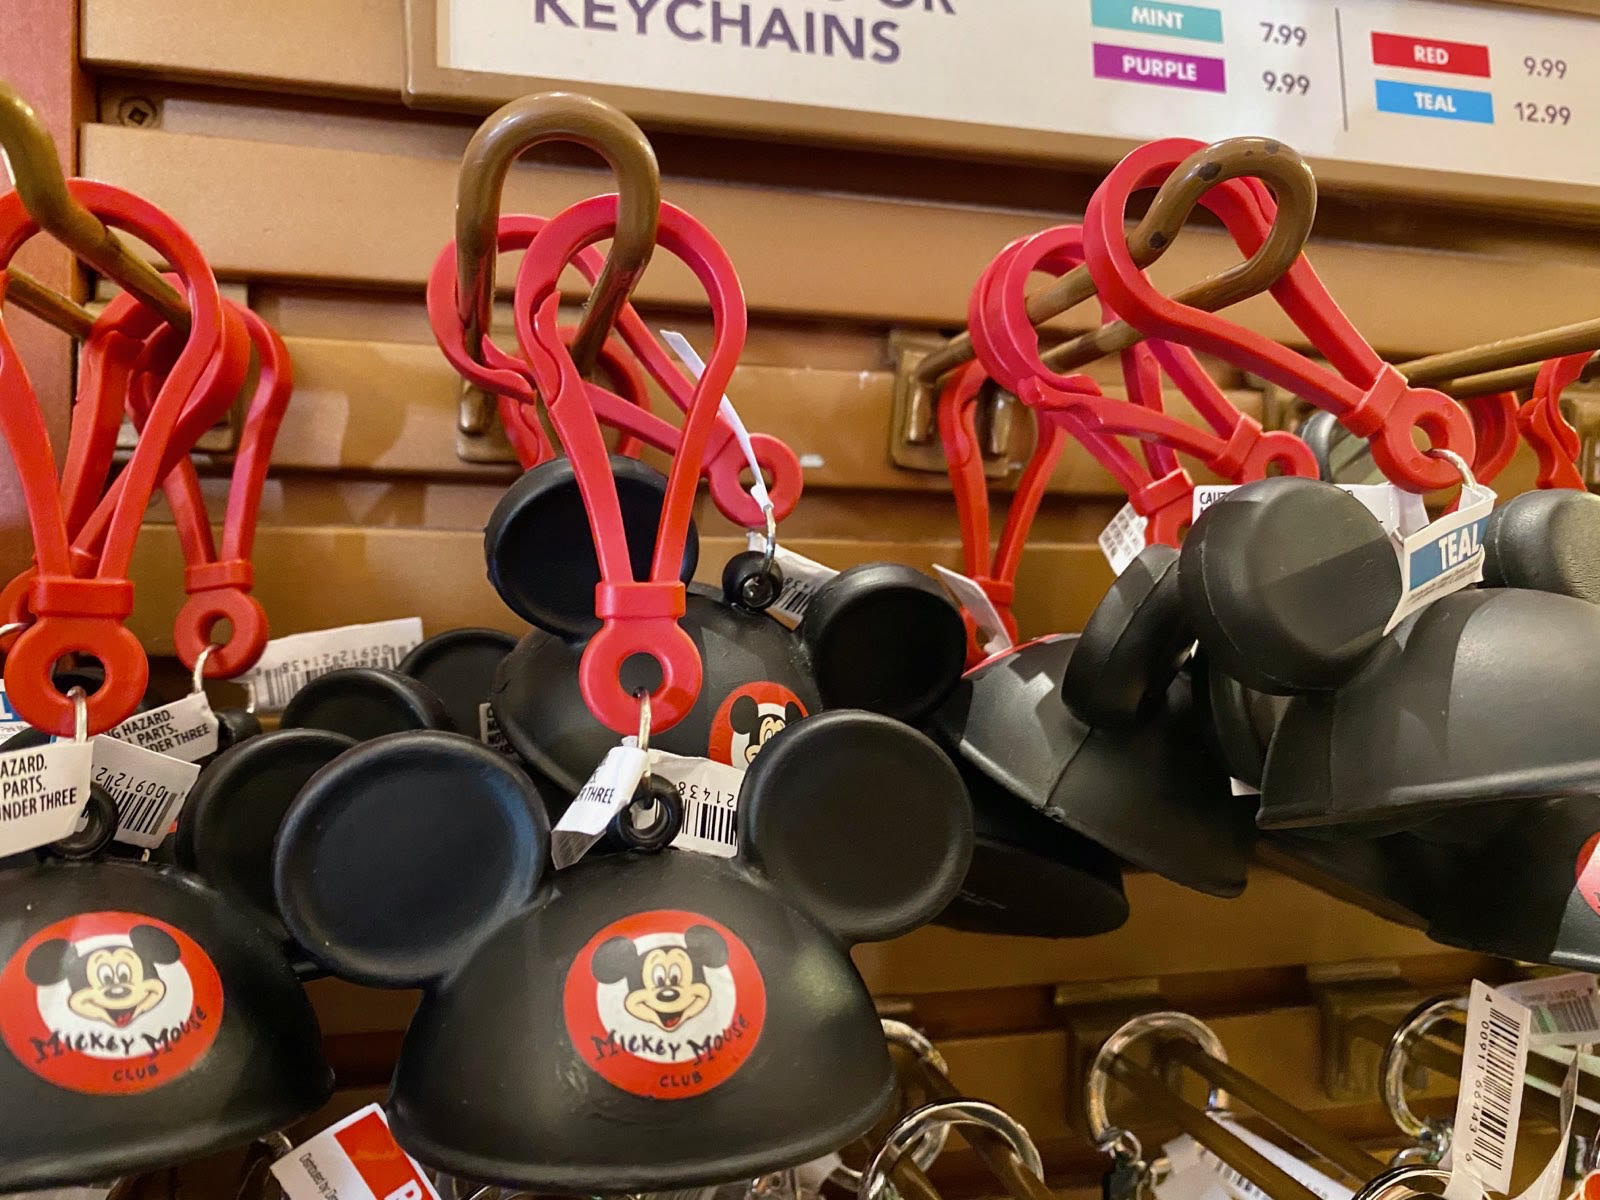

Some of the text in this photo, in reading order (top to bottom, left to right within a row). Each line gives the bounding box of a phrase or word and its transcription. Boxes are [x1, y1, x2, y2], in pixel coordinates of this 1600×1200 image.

[534, 0, 900, 63] KEYCHAINS
[1131, 5, 1307, 47] MINT 7.99
[1122, 54, 1310, 96] PURPLE 9.99
[1413, 44, 1568, 80] RED 9.99
[1413, 91, 1572, 125] TEAL 12.99
[1438, 523, 1480, 571] TEAL
[121, 710, 175, 736] HAZARD.
[137, 722, 178, 745] PARTS.
[174, 723, 211, 746] THREE
[0, 753, 48, 778] AZARD.
[3, 774, 46, 800] PARTS.
[585, 787, 615, 804] THREE
[677, 781, 735, 808] 21438
[0, 787, 77, 822] NDER THREE
[112, 1065, 159, 1082] CLUB
[659, 1071, 703, 1088] CLUB
